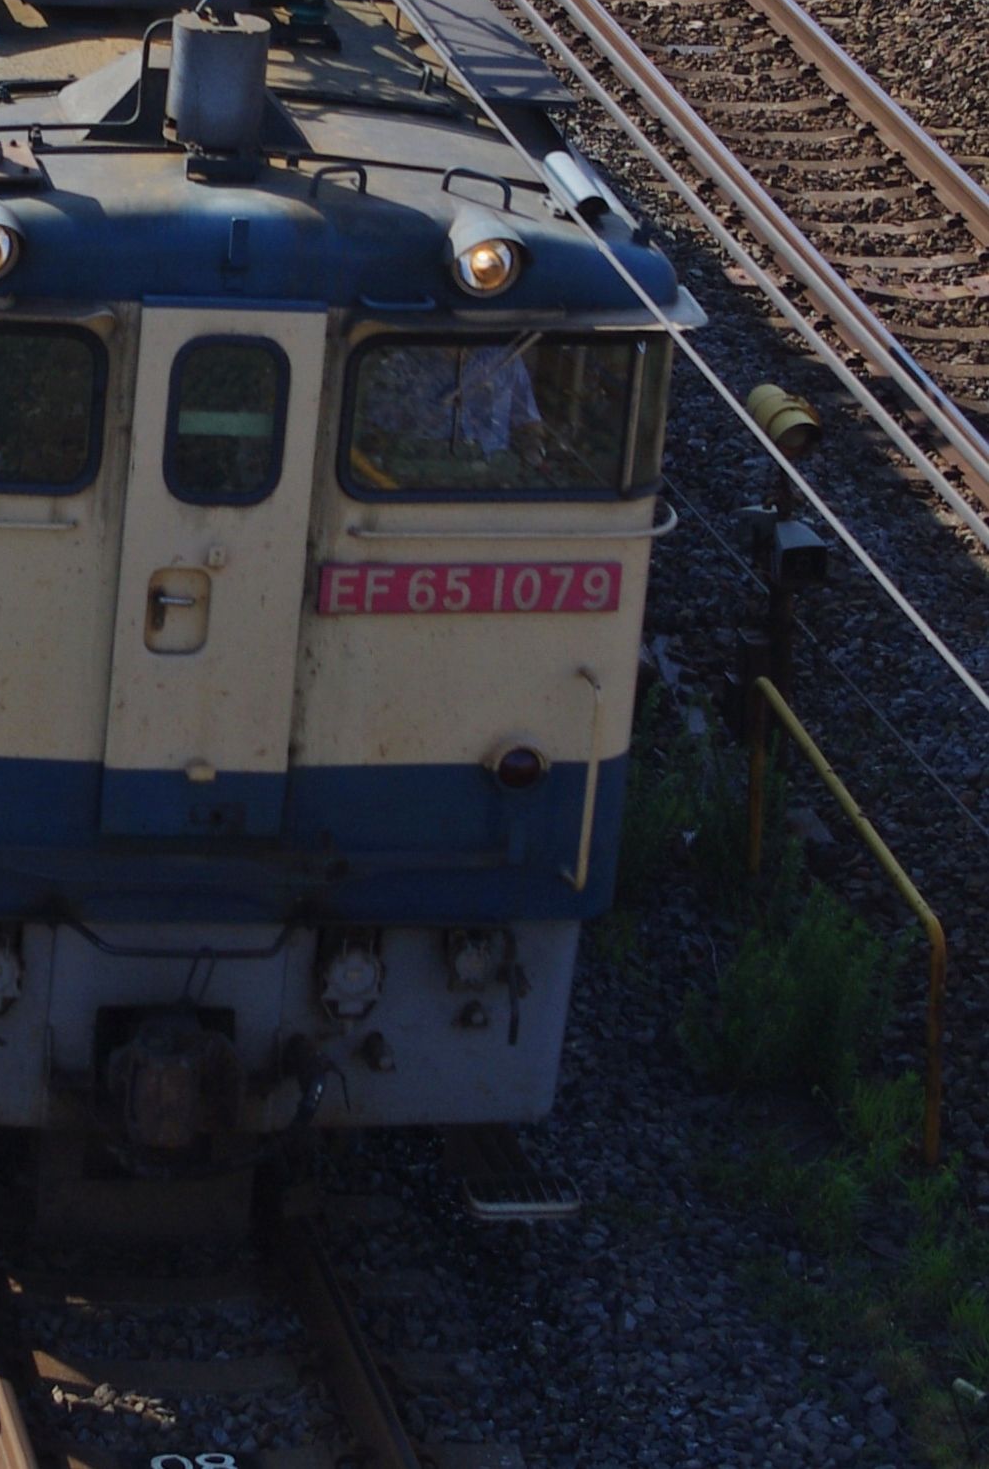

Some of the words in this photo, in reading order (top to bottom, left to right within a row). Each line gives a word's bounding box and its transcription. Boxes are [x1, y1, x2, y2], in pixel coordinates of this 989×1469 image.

[329, 568, 395, 612] EF
[407, 567, 471, 612] 65
[492, 567, 612, 611] 1079
